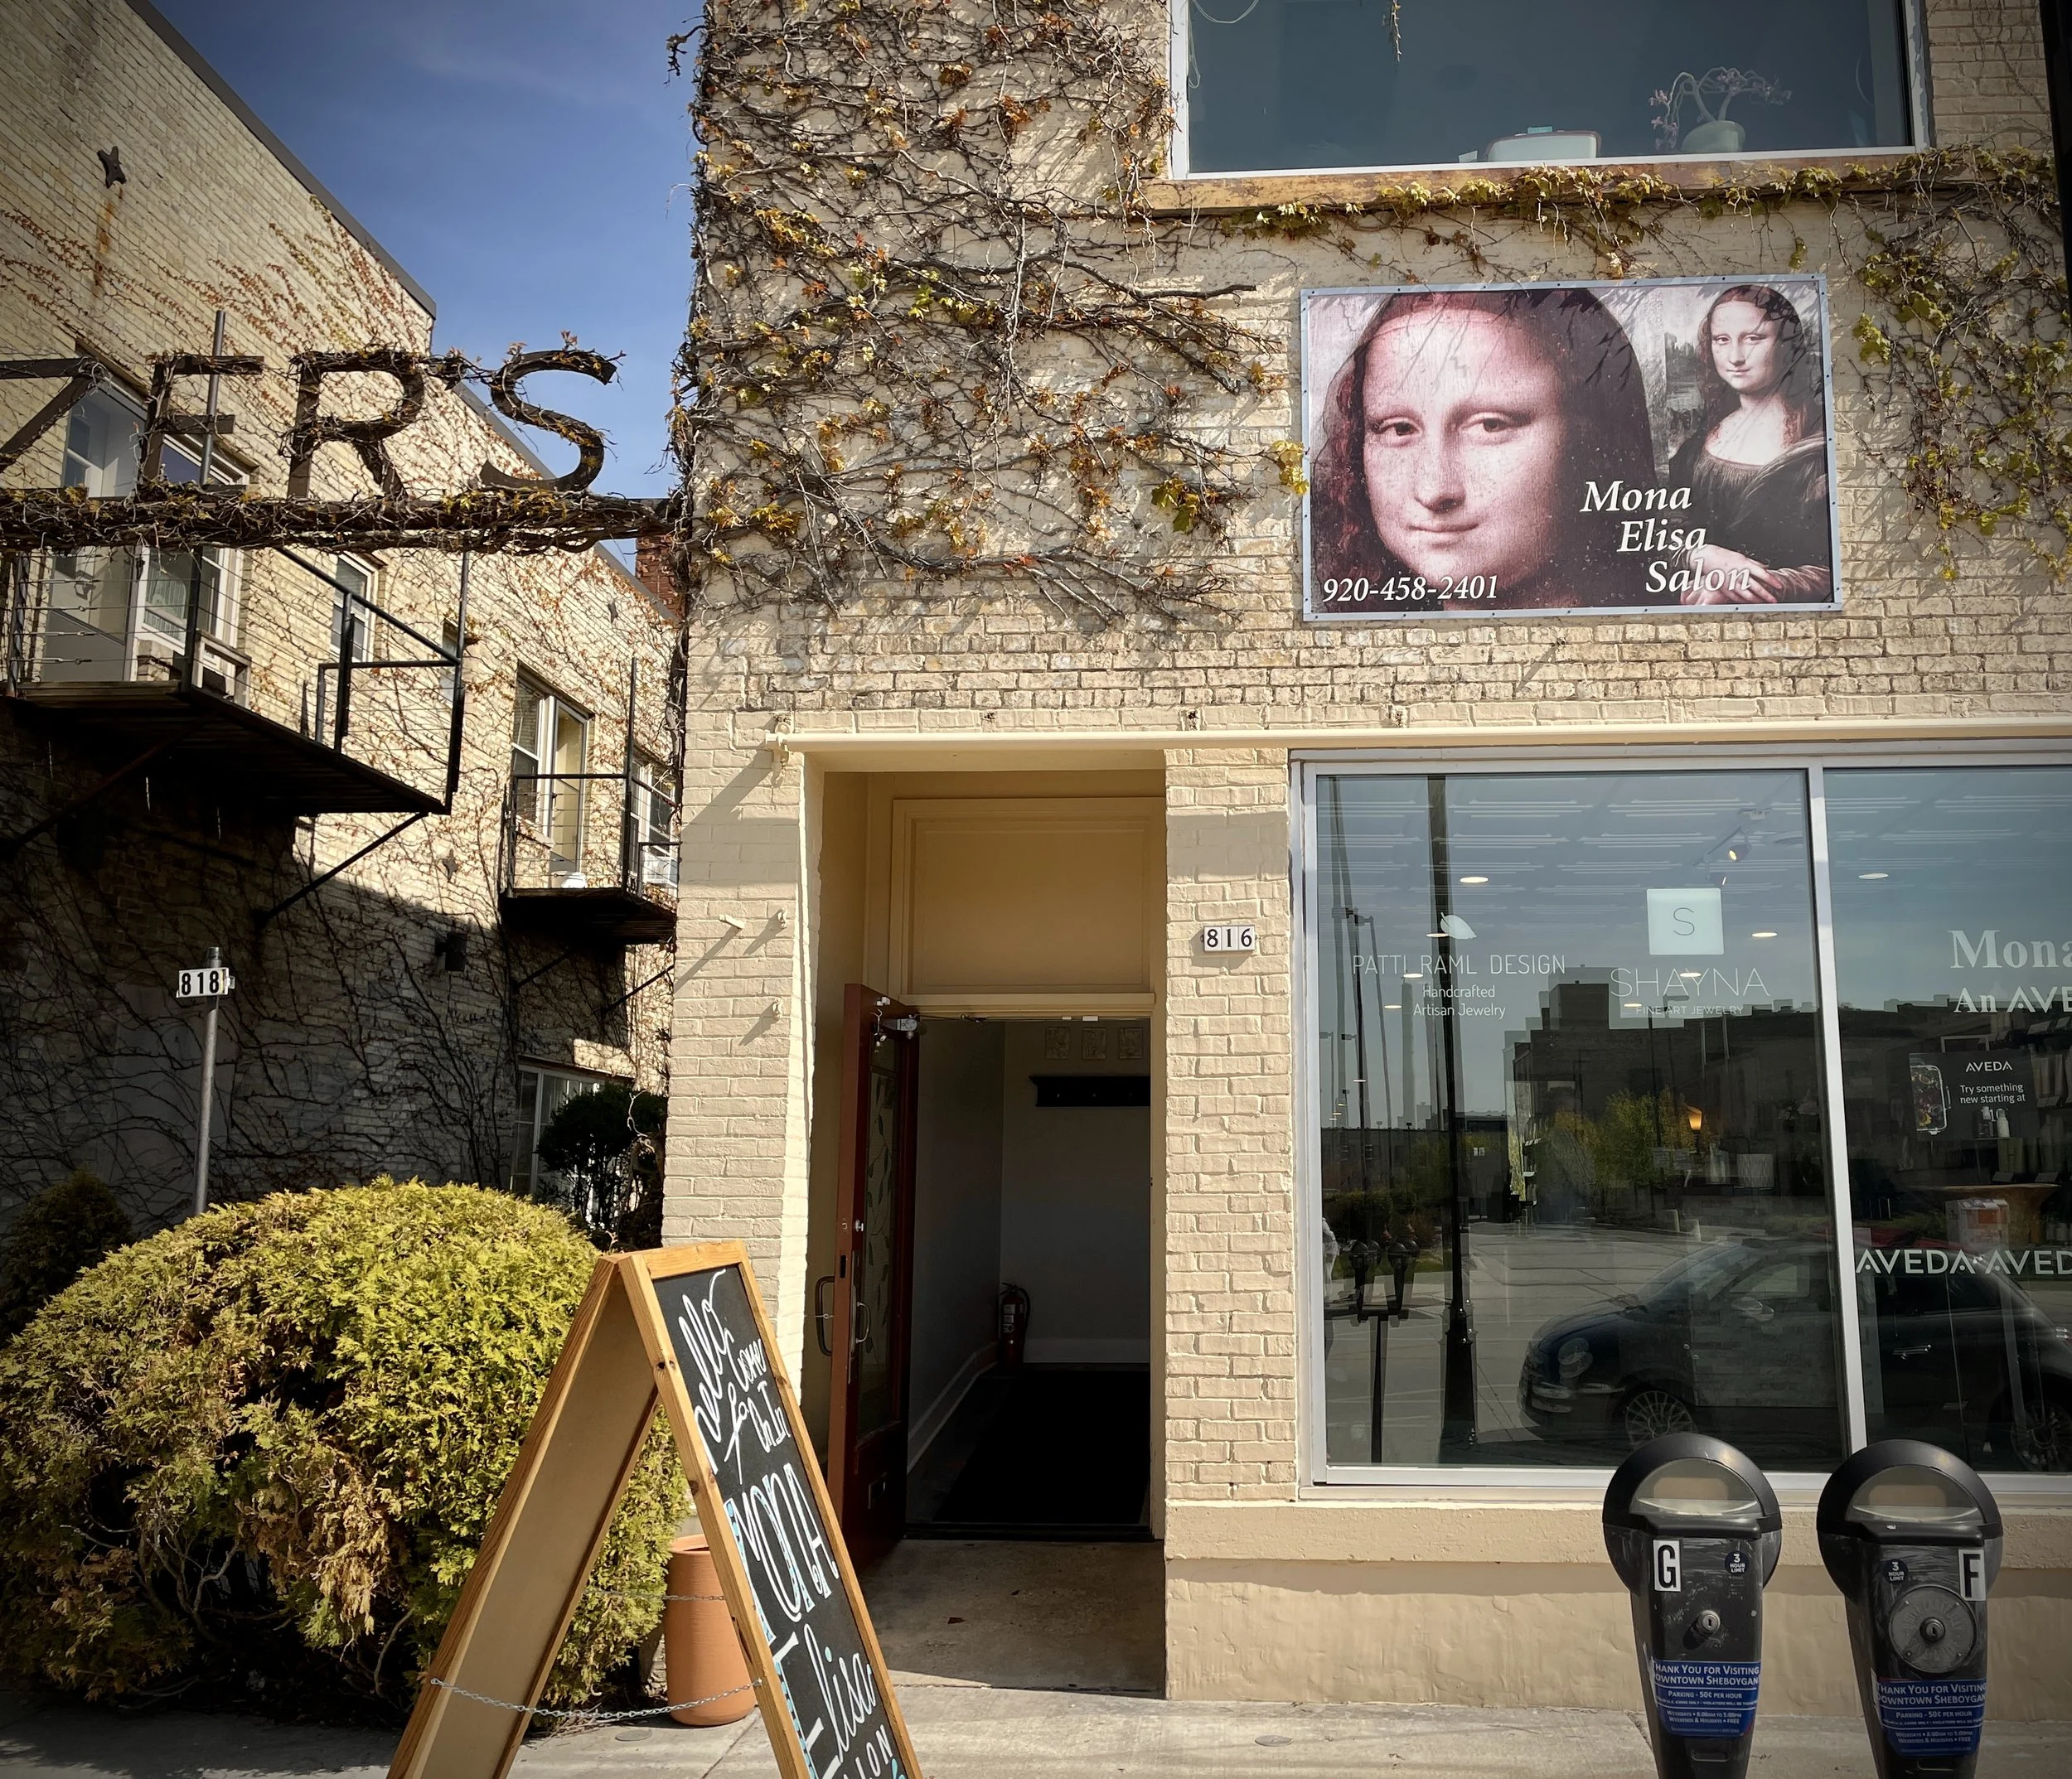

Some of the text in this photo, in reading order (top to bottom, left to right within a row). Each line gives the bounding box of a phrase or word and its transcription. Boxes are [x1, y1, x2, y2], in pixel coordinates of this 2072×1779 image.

[1580, 480, 1692, 513] Mona
[1616, 518, 1707, 553] Elisa
[1645, 558, 1750, 593] Salon
[1322, 575, 1498, 603] 920-458-2401
[1672, 907, 1695, 936] S
[1207, 928, 1252, 948] 816
[1353, 955, 1566, 975] PATTI RAML DESIGN
[181, 971, 220, 995] 818
[1422, 984, 1495, 998] Handcrafted
[1610, 967, 1771, 998] SHAYNA
[1635, 1005, 1744, 1015] FINE ART JEWELRY
[1953, 987, 1998, 1013] An
[1413, 1003, 1507, 1020] Artisan Jewelry
[1965, 1061, 2013, 1072] AVEDA
[1959, 1082, 2024, 1095] Try something
[1959, 1093, 2026, 1105] new starting at
[1856, 1249, 1976, 1274] AVEDA
[1657, 1544, 1677, 1589] G
[1733, 1554, 1740, 1563] 3
[1891, 1561, 1900, 1571] 3
[1962, 1553, 1982, 1598] F
[1655, 1674, 1705, 1685] OWNTOWN
[1681, 1665, 1702, 1675] YOU
[1703, 1666, 1721, 1675] FOR
[1722, 1665, 1760, 1675] VISITING
[1908, 1685, 1929, 1694] YOU
[1931, 1685, 1949, 1694] FOR
